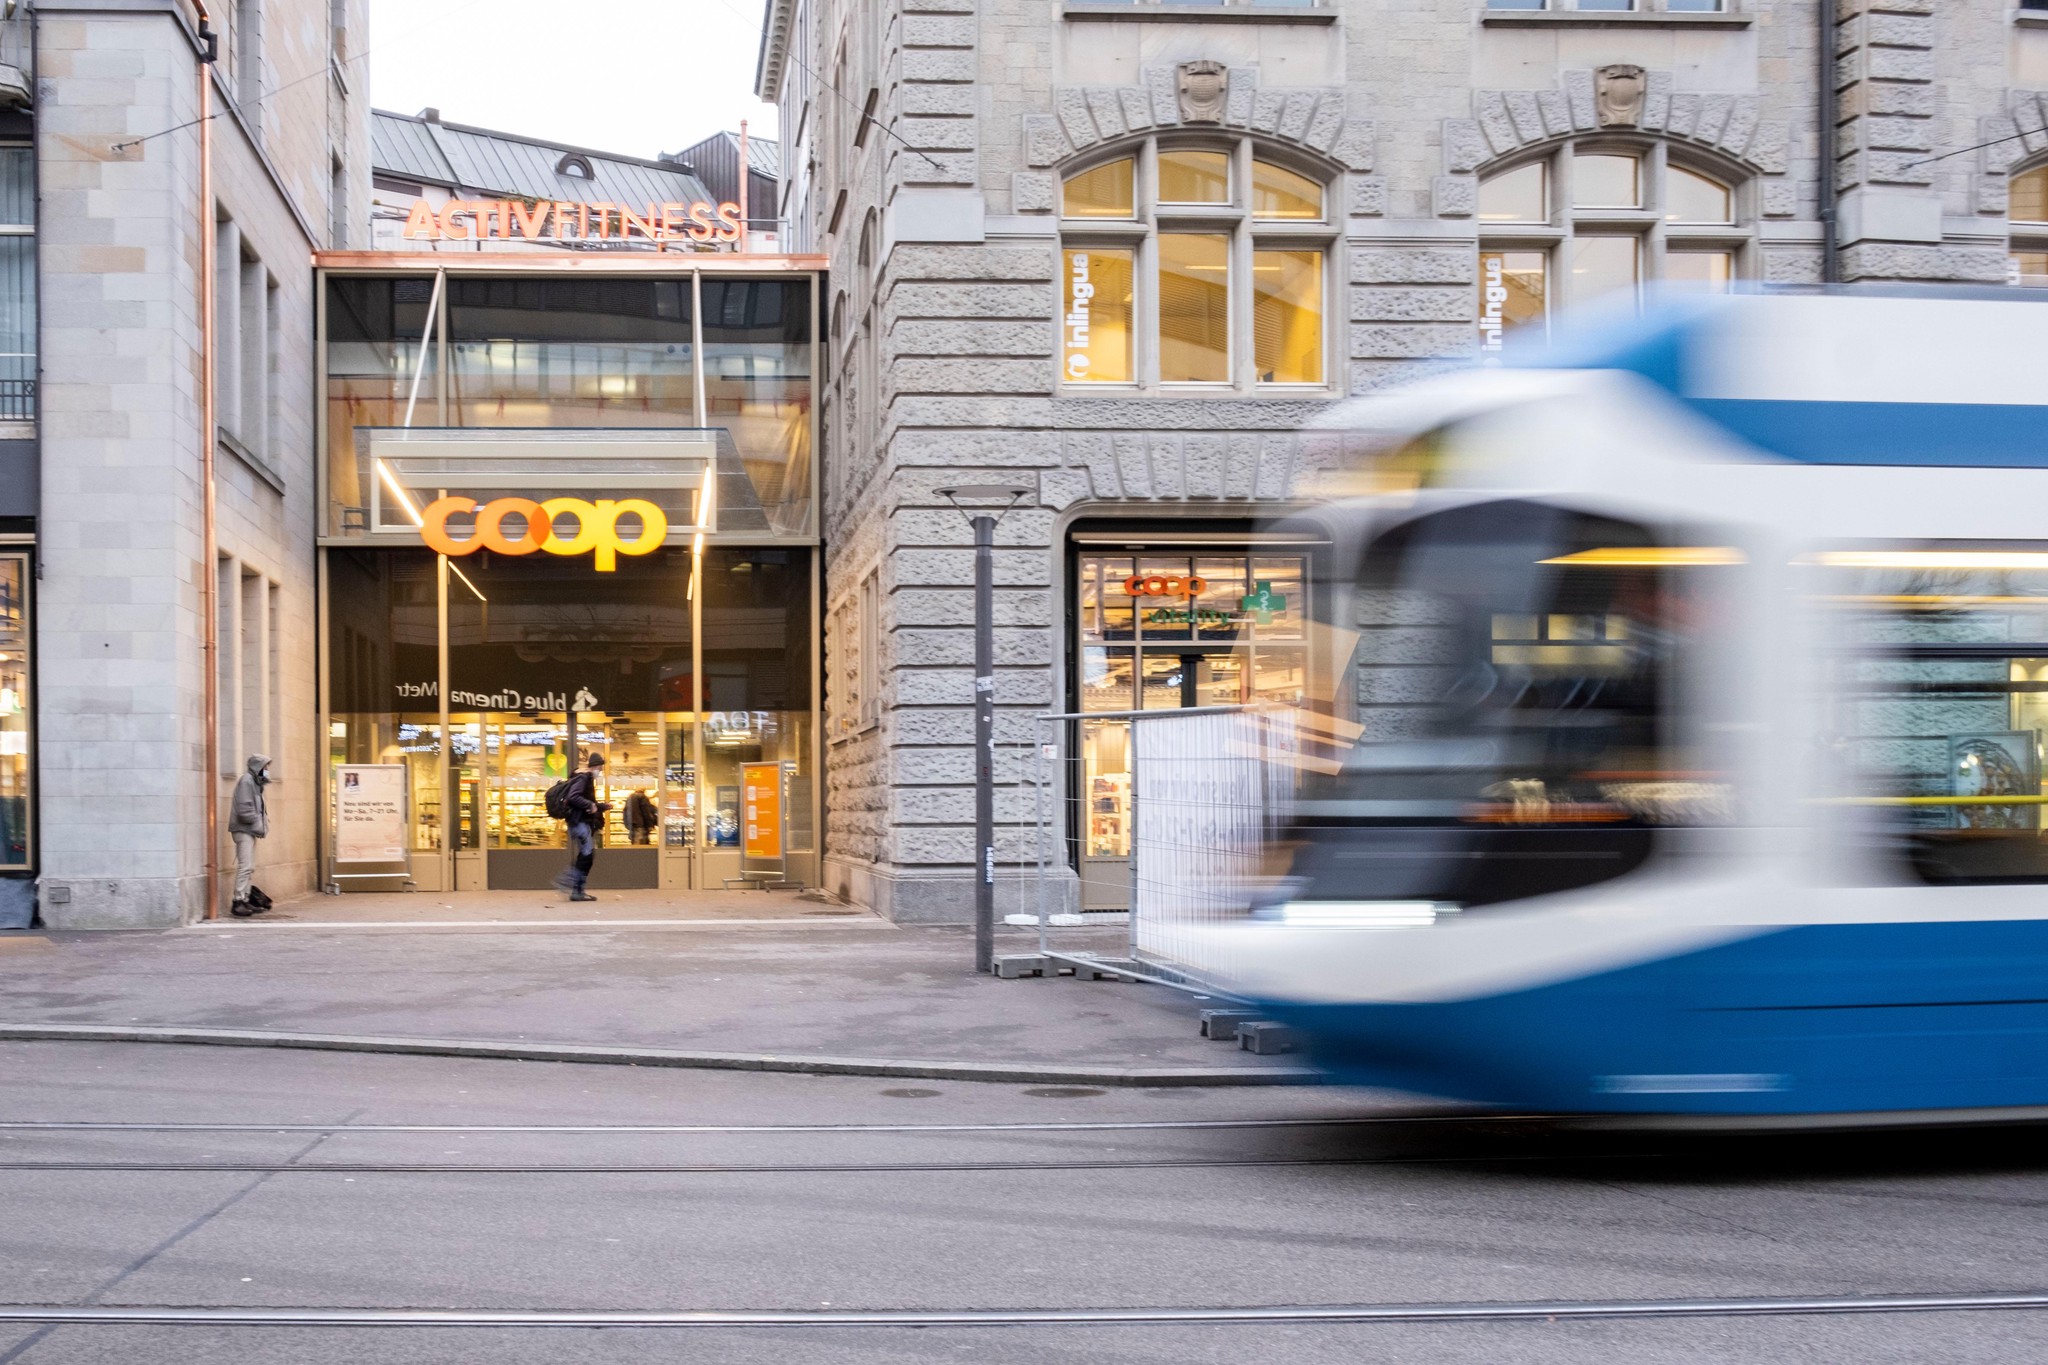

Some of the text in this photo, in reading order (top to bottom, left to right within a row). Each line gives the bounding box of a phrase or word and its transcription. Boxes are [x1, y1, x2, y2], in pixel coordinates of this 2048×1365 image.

[1066, 254, 1095, 348] inlingua
[1479, 258, 1507, 351] inlingua
[421, 496, 668, 572] coop
[1124, 575, 1207, 601] coop
[1149, 606, 1231, 626] vitality
